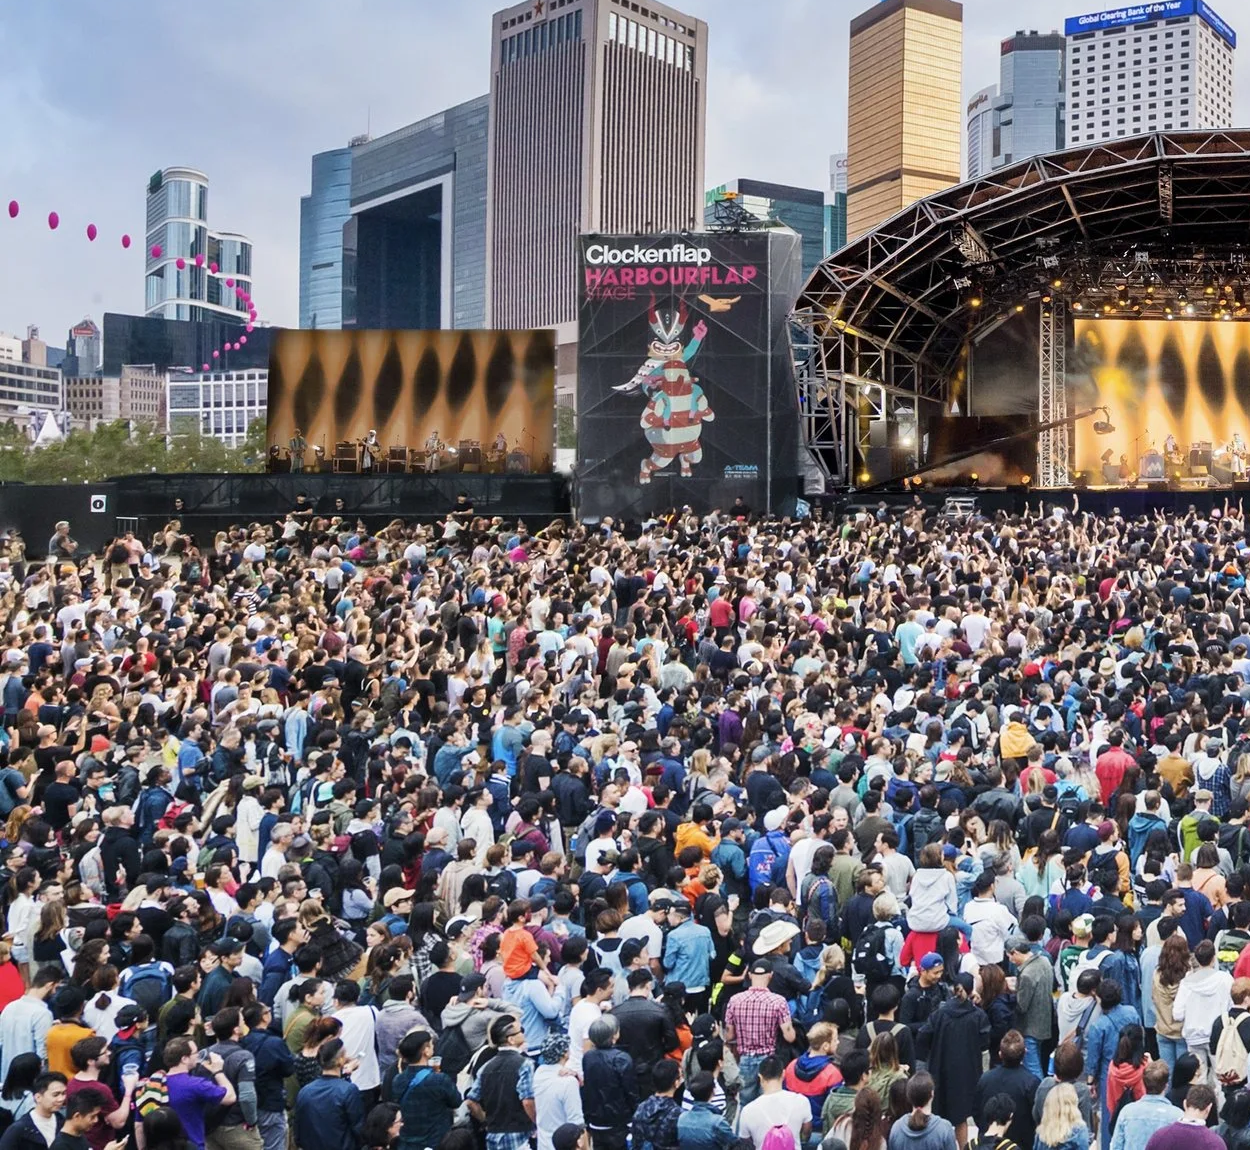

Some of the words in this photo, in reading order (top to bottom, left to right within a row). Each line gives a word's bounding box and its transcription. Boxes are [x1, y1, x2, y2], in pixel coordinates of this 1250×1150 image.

[1079, 13, 1100, 25] Global
[1100, 10, 1127, 21] Clearing
[1127, 6, 1145, 17] Bank
[1145, 4, 1153, 14] of
[1153, 3, 1165, 12] the
[1165, 1, 1182, 10] Year
[585, 243, 712, 266] Clockenflap
[585, 265, 757, 287] HARBOURFLAP
[585, 286, 636, 300] STAGE
